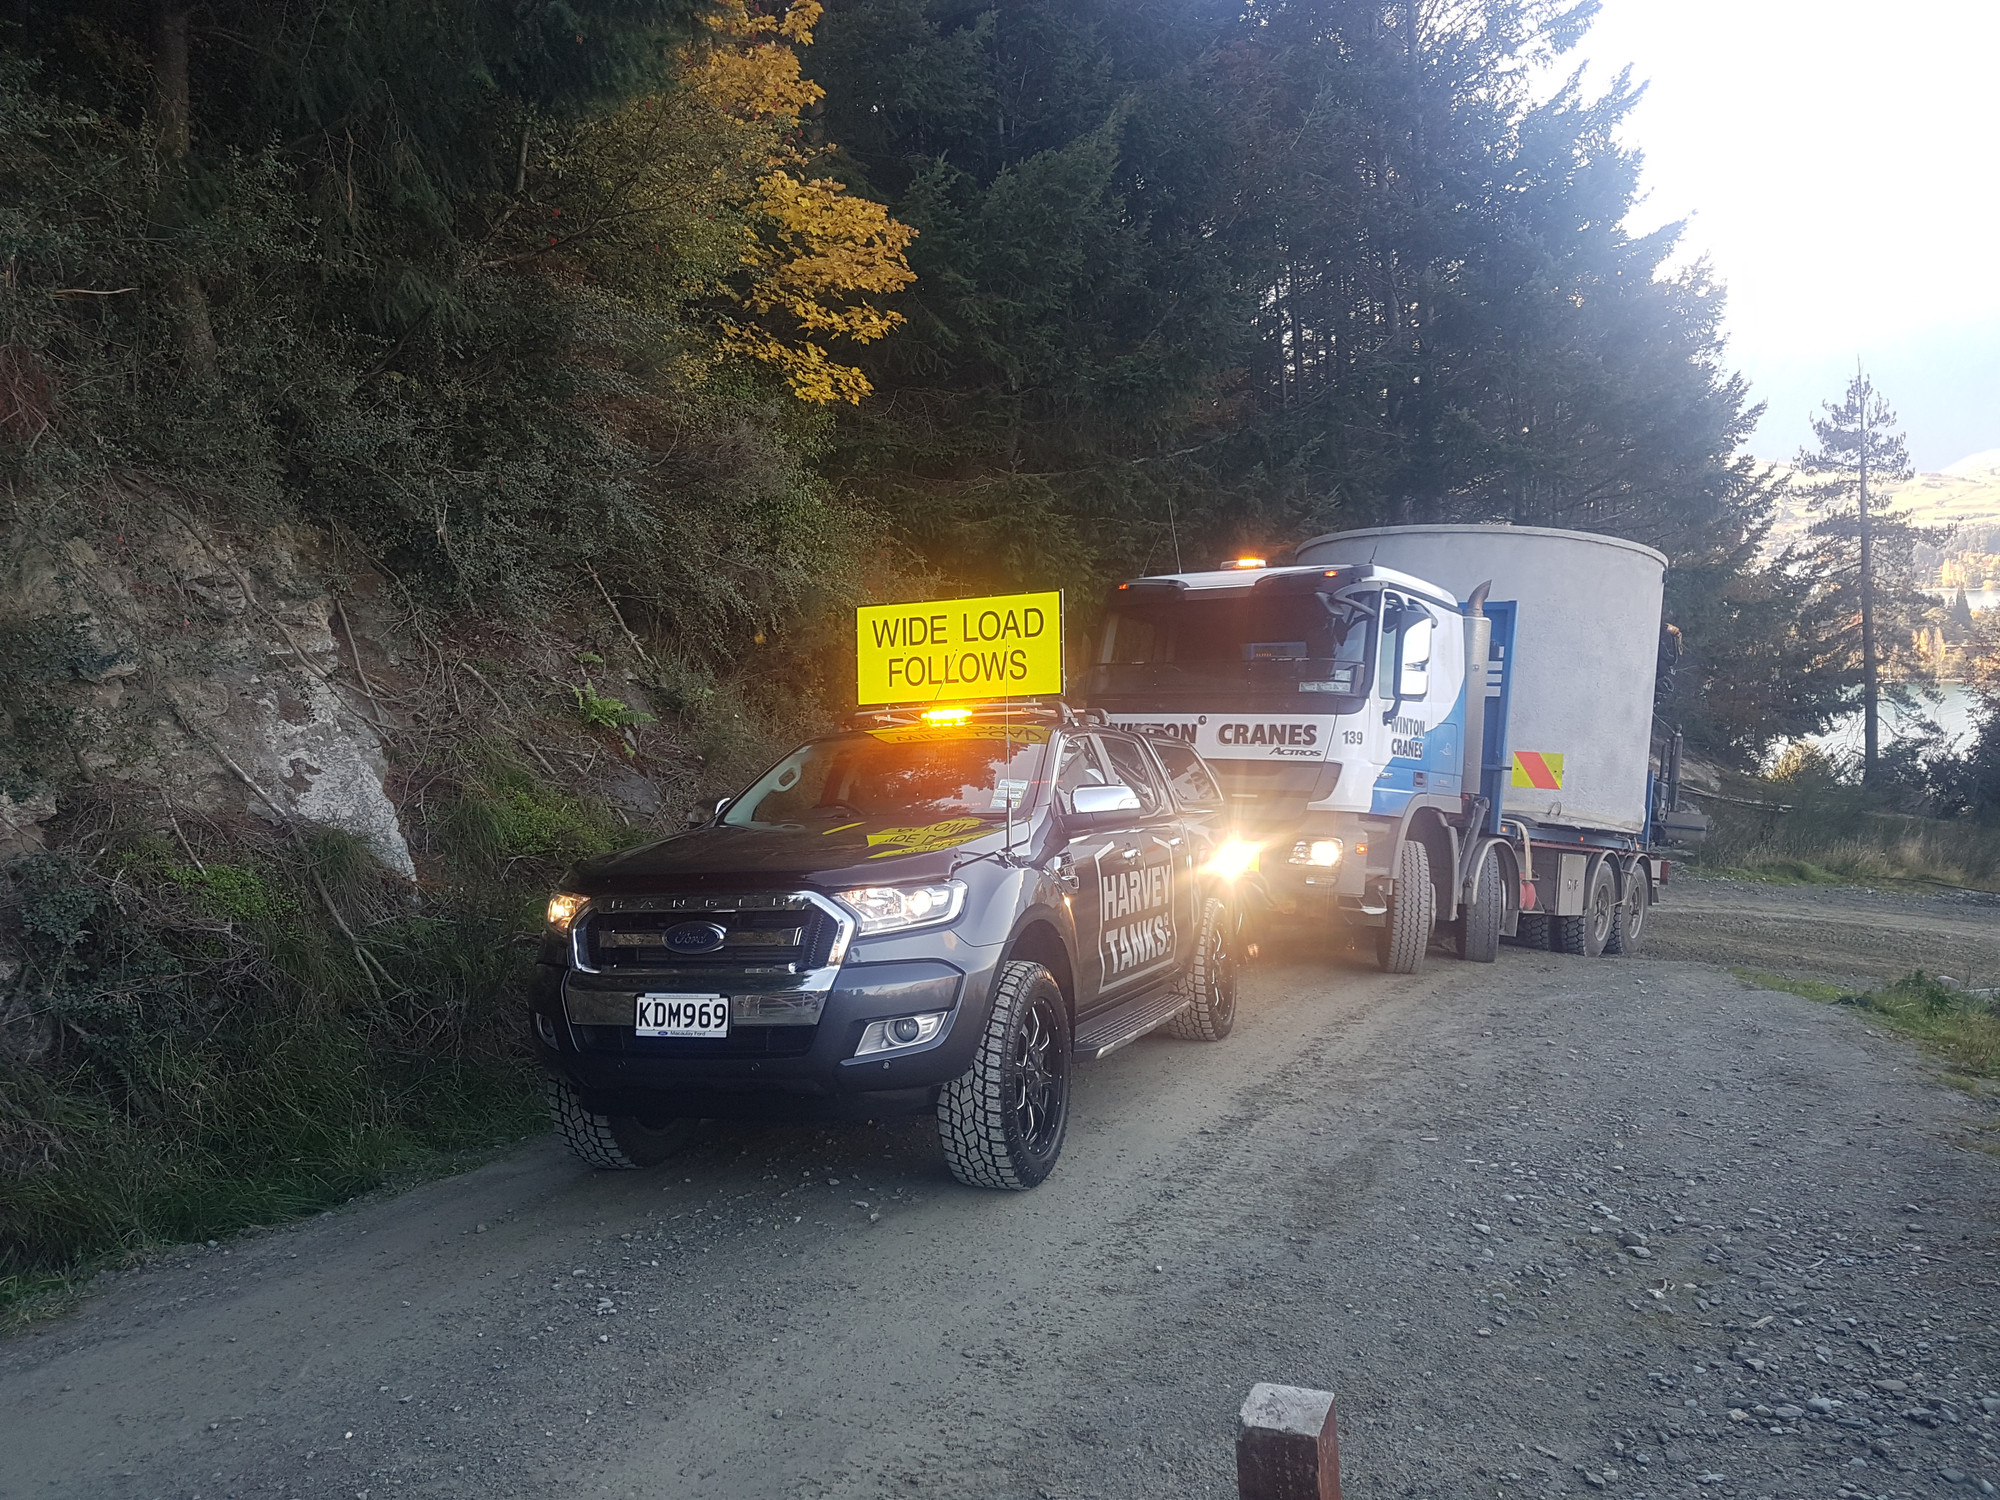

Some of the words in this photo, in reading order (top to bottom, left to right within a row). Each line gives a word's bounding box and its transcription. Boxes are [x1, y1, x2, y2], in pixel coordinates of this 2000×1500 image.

[872, 614, 948, 648] WIDE
[963, 608, 1044, 642] LOAD
[888, 649, 1028, 687] FOLLOWS
[1218, 723, 1317, 746] CRANES
[1342, 731, 1363, 745] 139
[1390, 716, 1425, 737] WINTON
[1391, 738, 1423, 759] CRANES
[611, 899, 786, 909] RANGR
[1103, 865, 1170, 921] HARVEY
[674, 929, 708, 945] Ford
[1105, 915, 1166, 974] TANKS
[638, 1002, 727, 1029] KDM969
